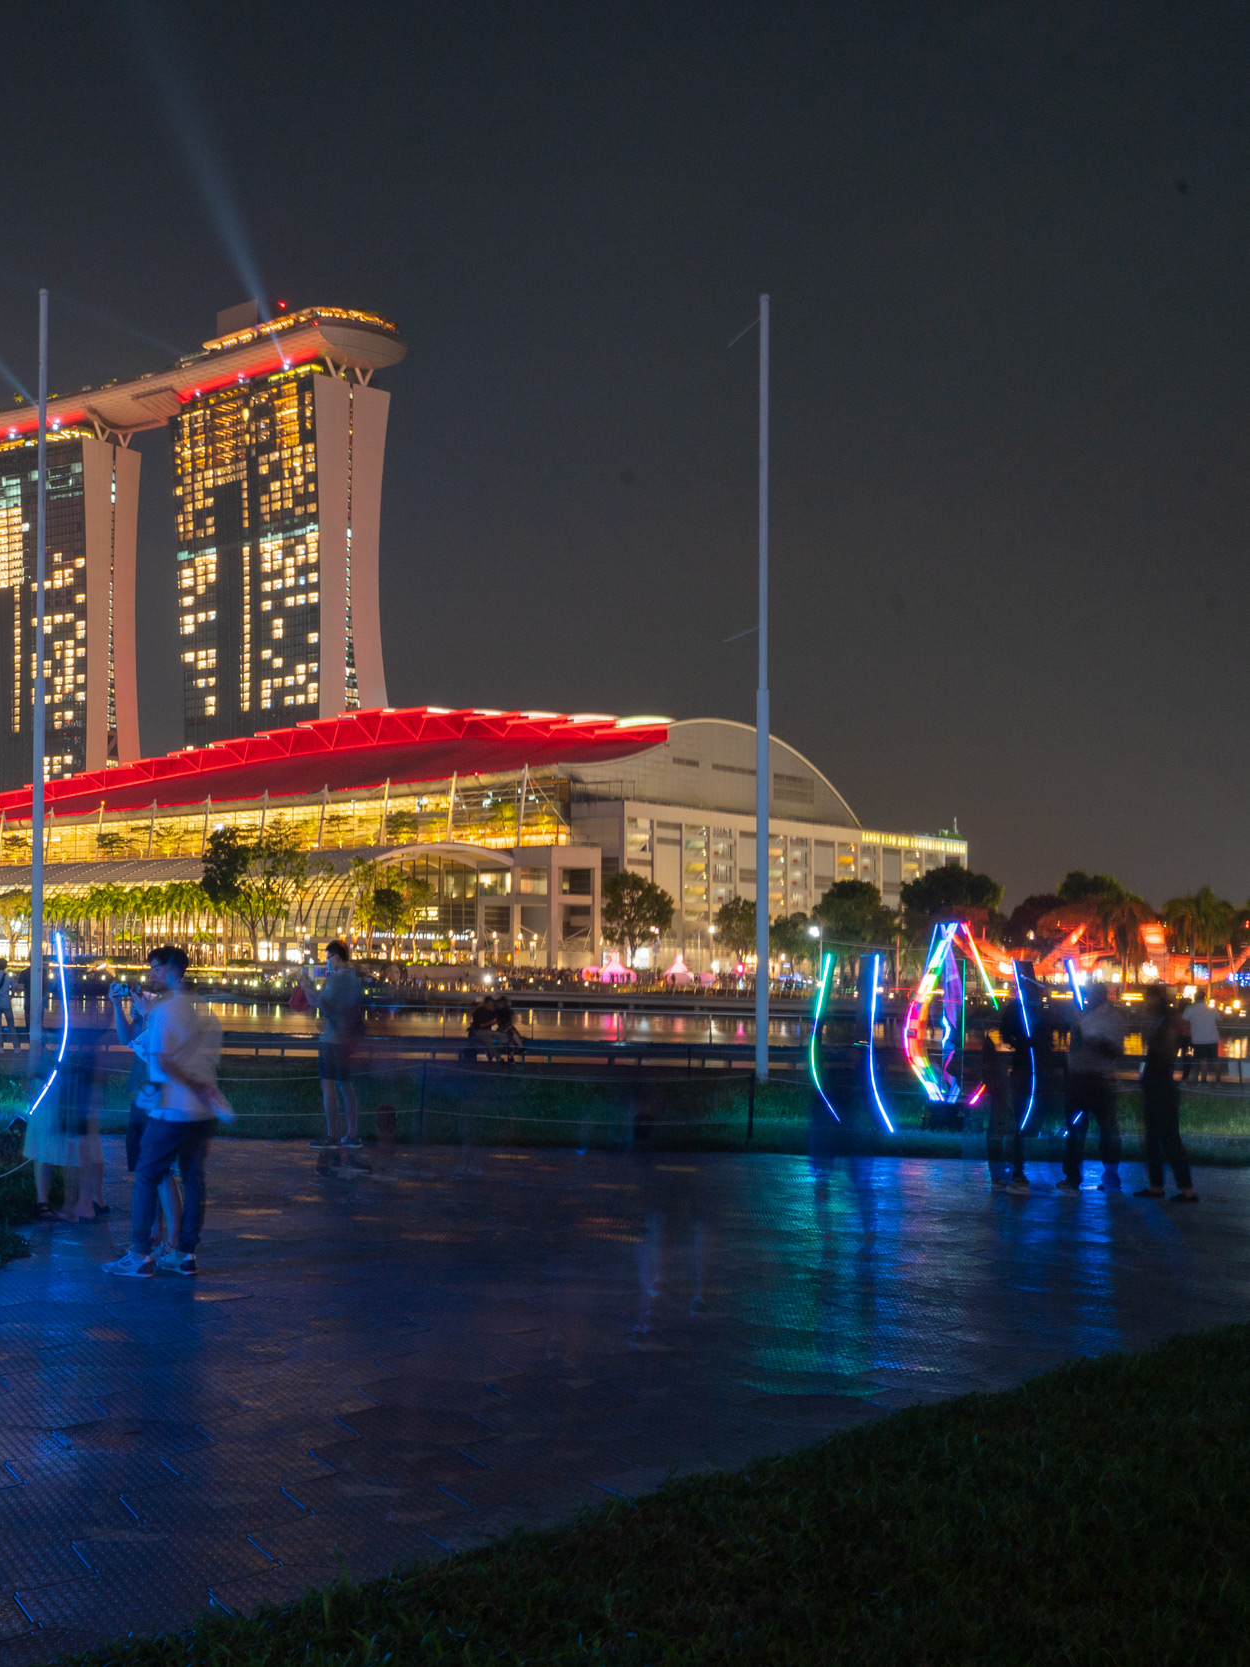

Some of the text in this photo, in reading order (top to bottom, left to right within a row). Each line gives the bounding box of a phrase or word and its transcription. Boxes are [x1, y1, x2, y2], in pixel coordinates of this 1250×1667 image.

[882, 834, 896, 846] EXPO
[898, 836, 909, 847] AND
[911, 838, 945, 851] CONVENTION
